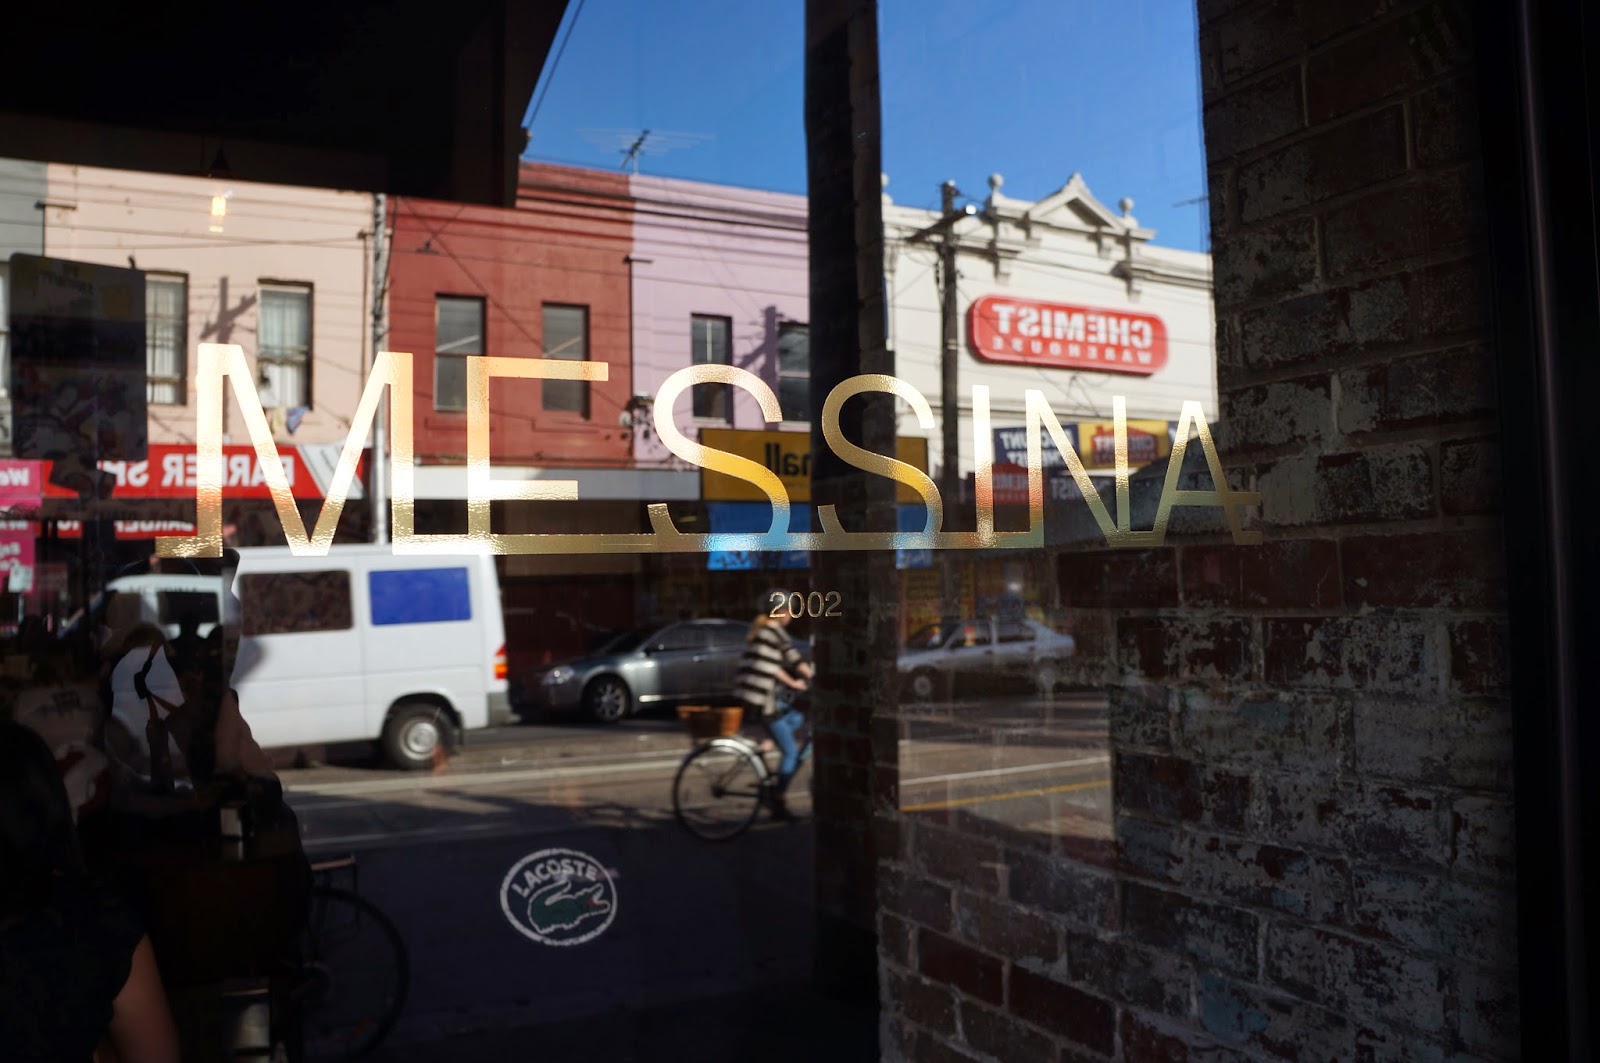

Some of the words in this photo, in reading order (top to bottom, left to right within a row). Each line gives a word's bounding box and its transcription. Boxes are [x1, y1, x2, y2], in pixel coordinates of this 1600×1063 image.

[155, 342, 1263, 556] MESSINA
[768, 590, 843, 619] 2002
[510, 858, 599, 898] LACOSTE
